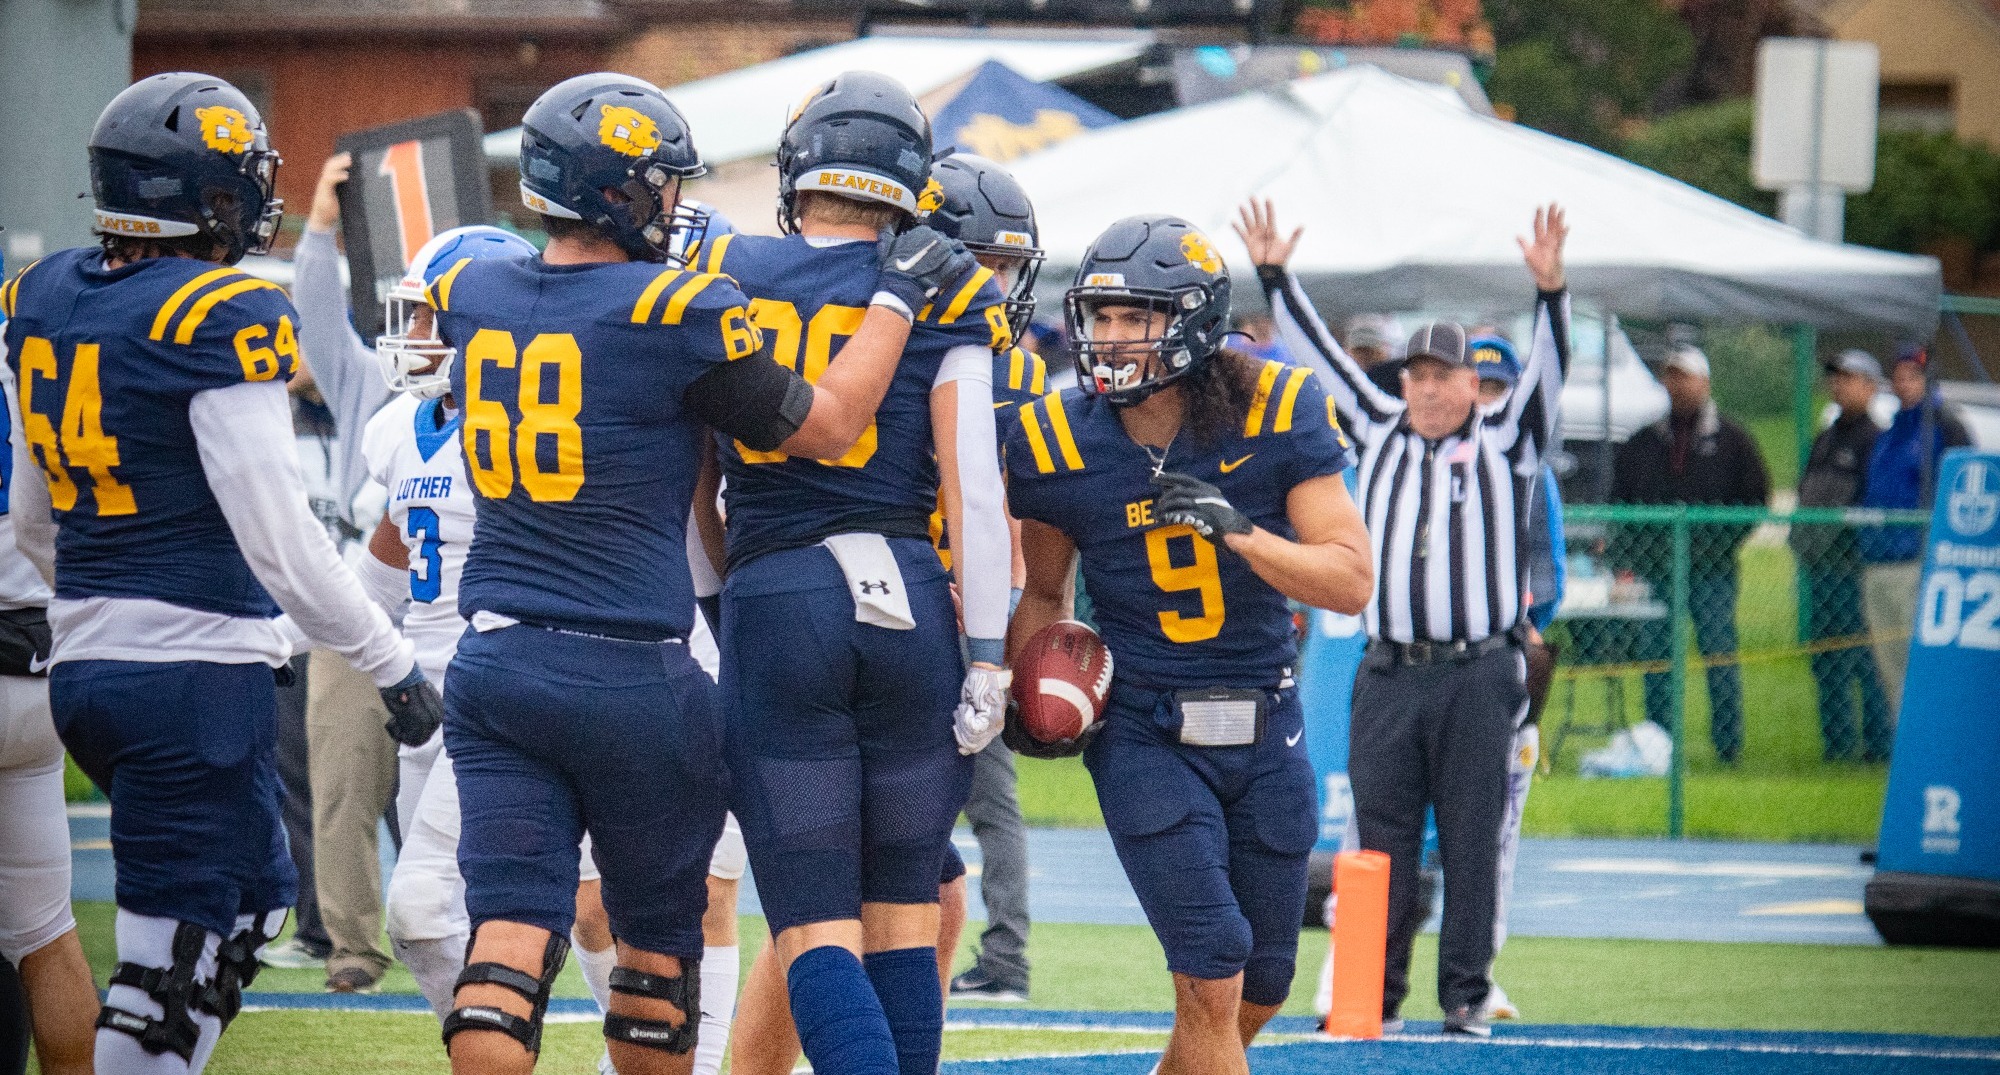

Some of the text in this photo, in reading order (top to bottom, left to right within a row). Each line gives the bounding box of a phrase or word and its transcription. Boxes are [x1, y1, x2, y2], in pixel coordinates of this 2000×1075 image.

[377, 140, 435, 270] 1
[819, 172, 903, 201] BEAVERS
[233, 314, 299, 382] 64
[19, 336, 138, 516] 64
[463, 328, 585, 502] 68
[396, 476, 453, 501] LUTHER
[407, 505, 448, 604] 3
[1145, 524, 1226, 644] 9
[1920, 568, 2000, 651] 02
